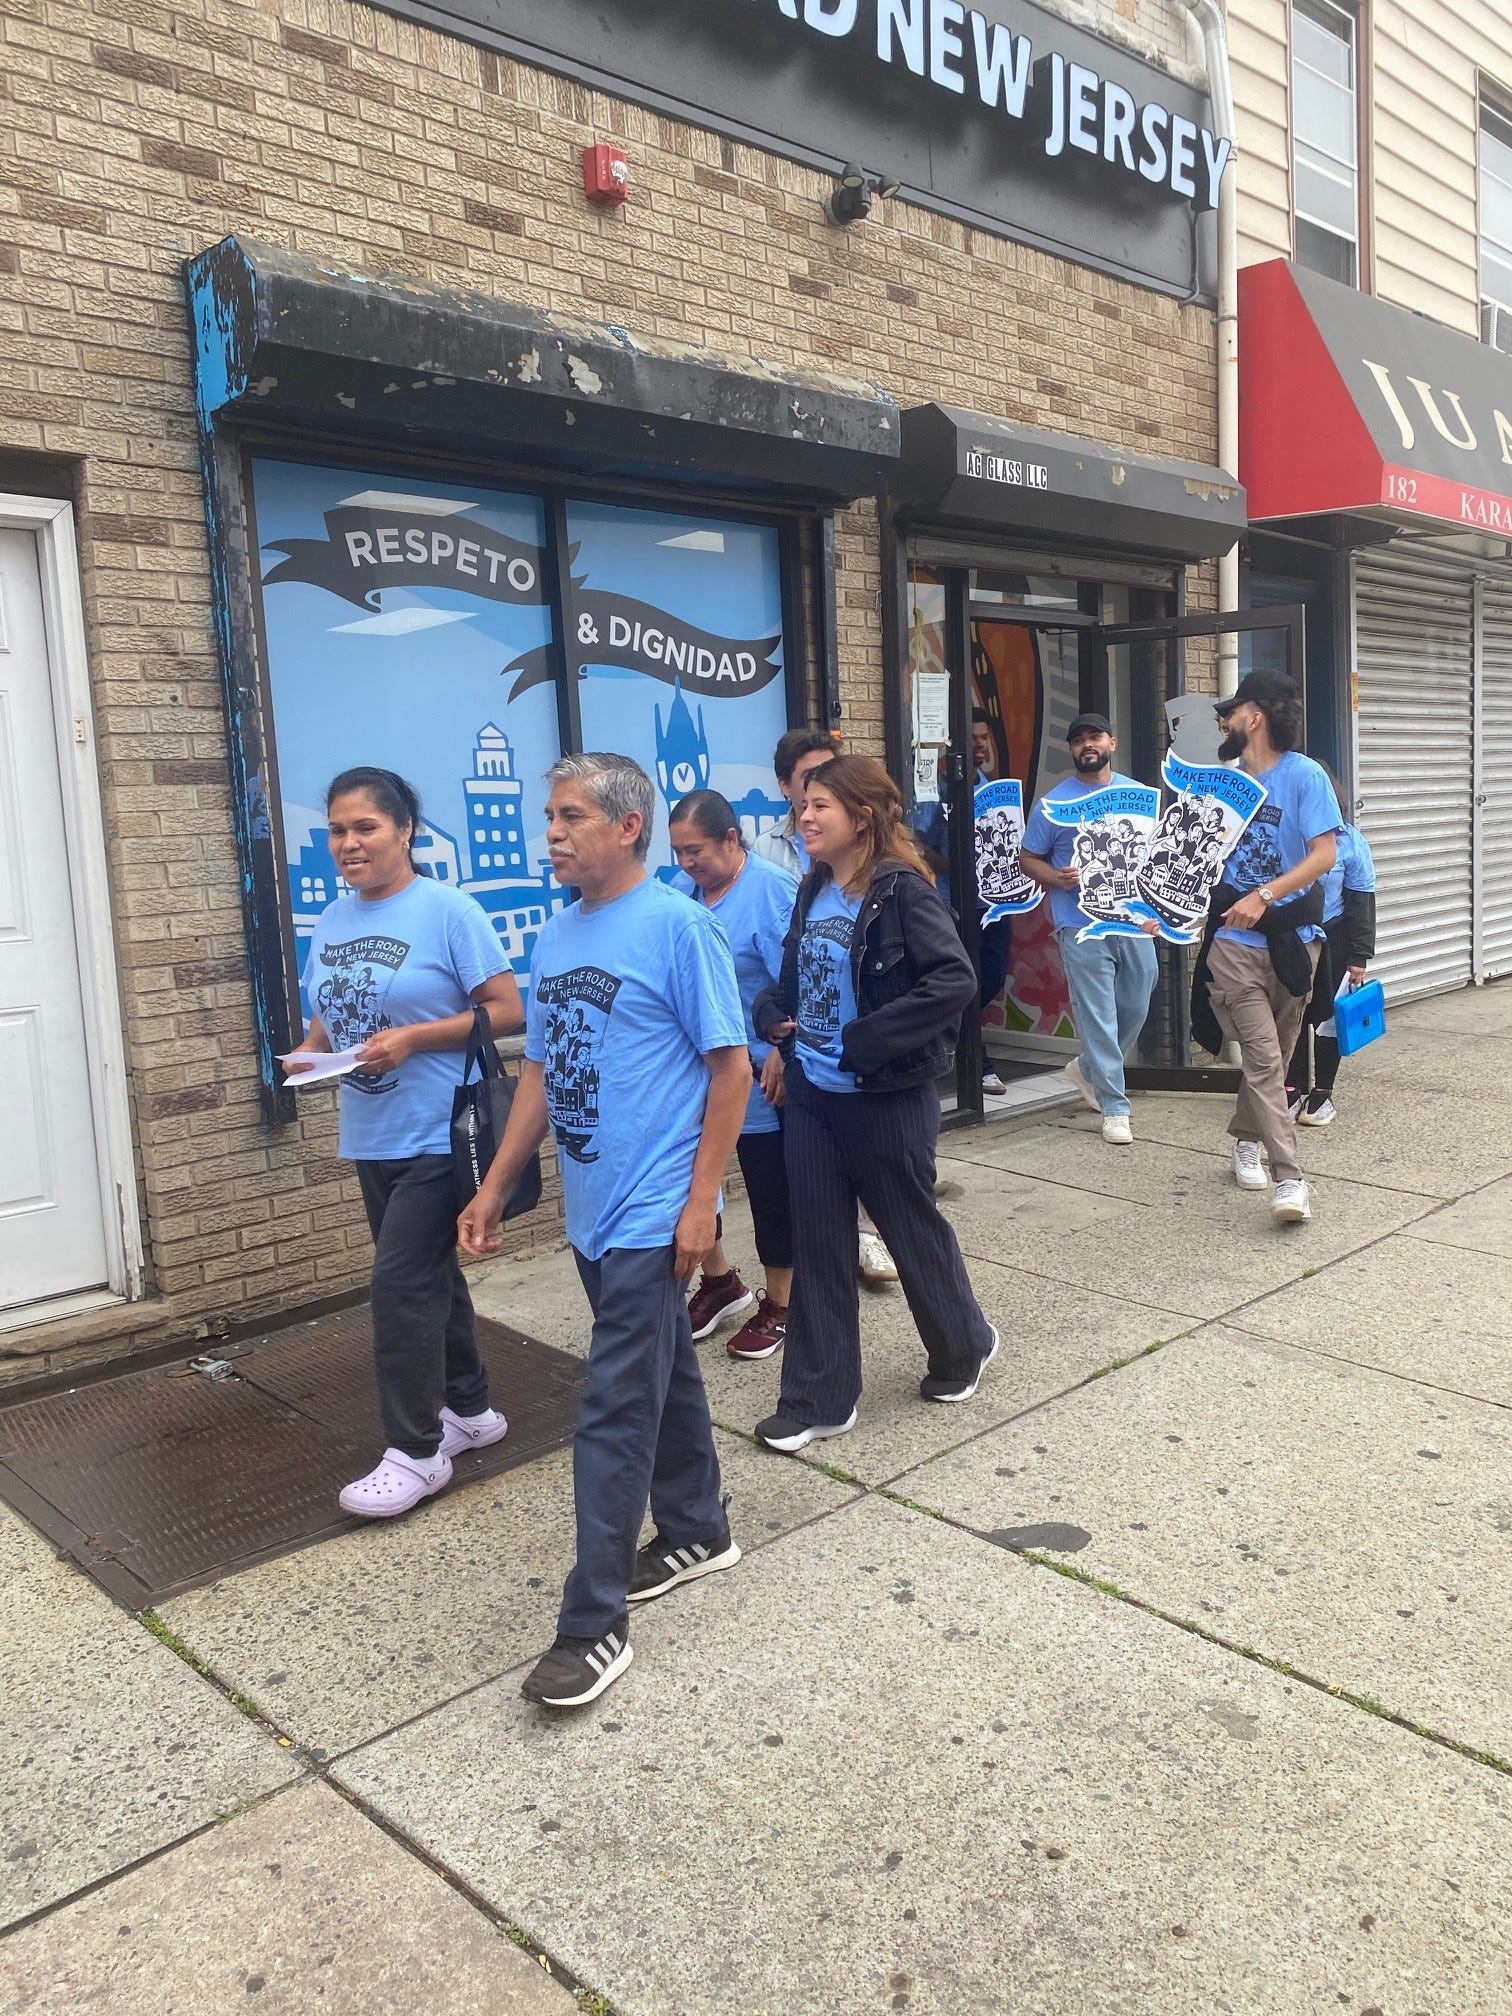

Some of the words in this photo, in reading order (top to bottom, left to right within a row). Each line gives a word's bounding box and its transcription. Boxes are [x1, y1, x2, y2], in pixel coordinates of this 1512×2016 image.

[877, 0, 1032, 119] NEW
[1045, 52, 1232, 210] JERSEY
[968, 453, 981, 476] AG
[988, 457, 1021, 484] GLASS
[1027, 464, 1047, 488] LLC
[1387, 474, 1417, 504] 182
[344, 527, 536, 592] RESPETO
[577, 612, 600, 646] &
[609, 614, 757, 683] DIGNIDAD
[979, 788, 995, 803] THE
[995, 785, 1019, 796] ROAD
[1173, 766, 1205, 783] MAKE
[1208, 772, 1231, 785] THE
[1229, 777, 1258, 803] ROAD
[994, 795, 1018, 804] JERSEY
[1060, 801, 1095, 817] MAKE
[1094, 791, 1118, 806] THE
[1120, 791, 1155, 803] ROAD
[1091, 804, 1113, 818] NEW
[1117, 802, 1153, 813] JERSEY
[1197, 784, 1220, 794] NEW
[1221, 789, 1251, 813] JERSEY
[325, 945, 353, 959] MAKE
[354, 939, 376, 952] THE
[375, 940, 406, 956] ROAD
[346, 951, 367, 963] NEW
[368, 950, 401, 965] JERSEY
[539, 978, 564, 993] MAKE
[566, 971, 586, 986] THE
[585, 971, 615, 993] ROAD
[560, 985, 579, 999] NEW
[580, 985, 610, 1005] JERSEY
